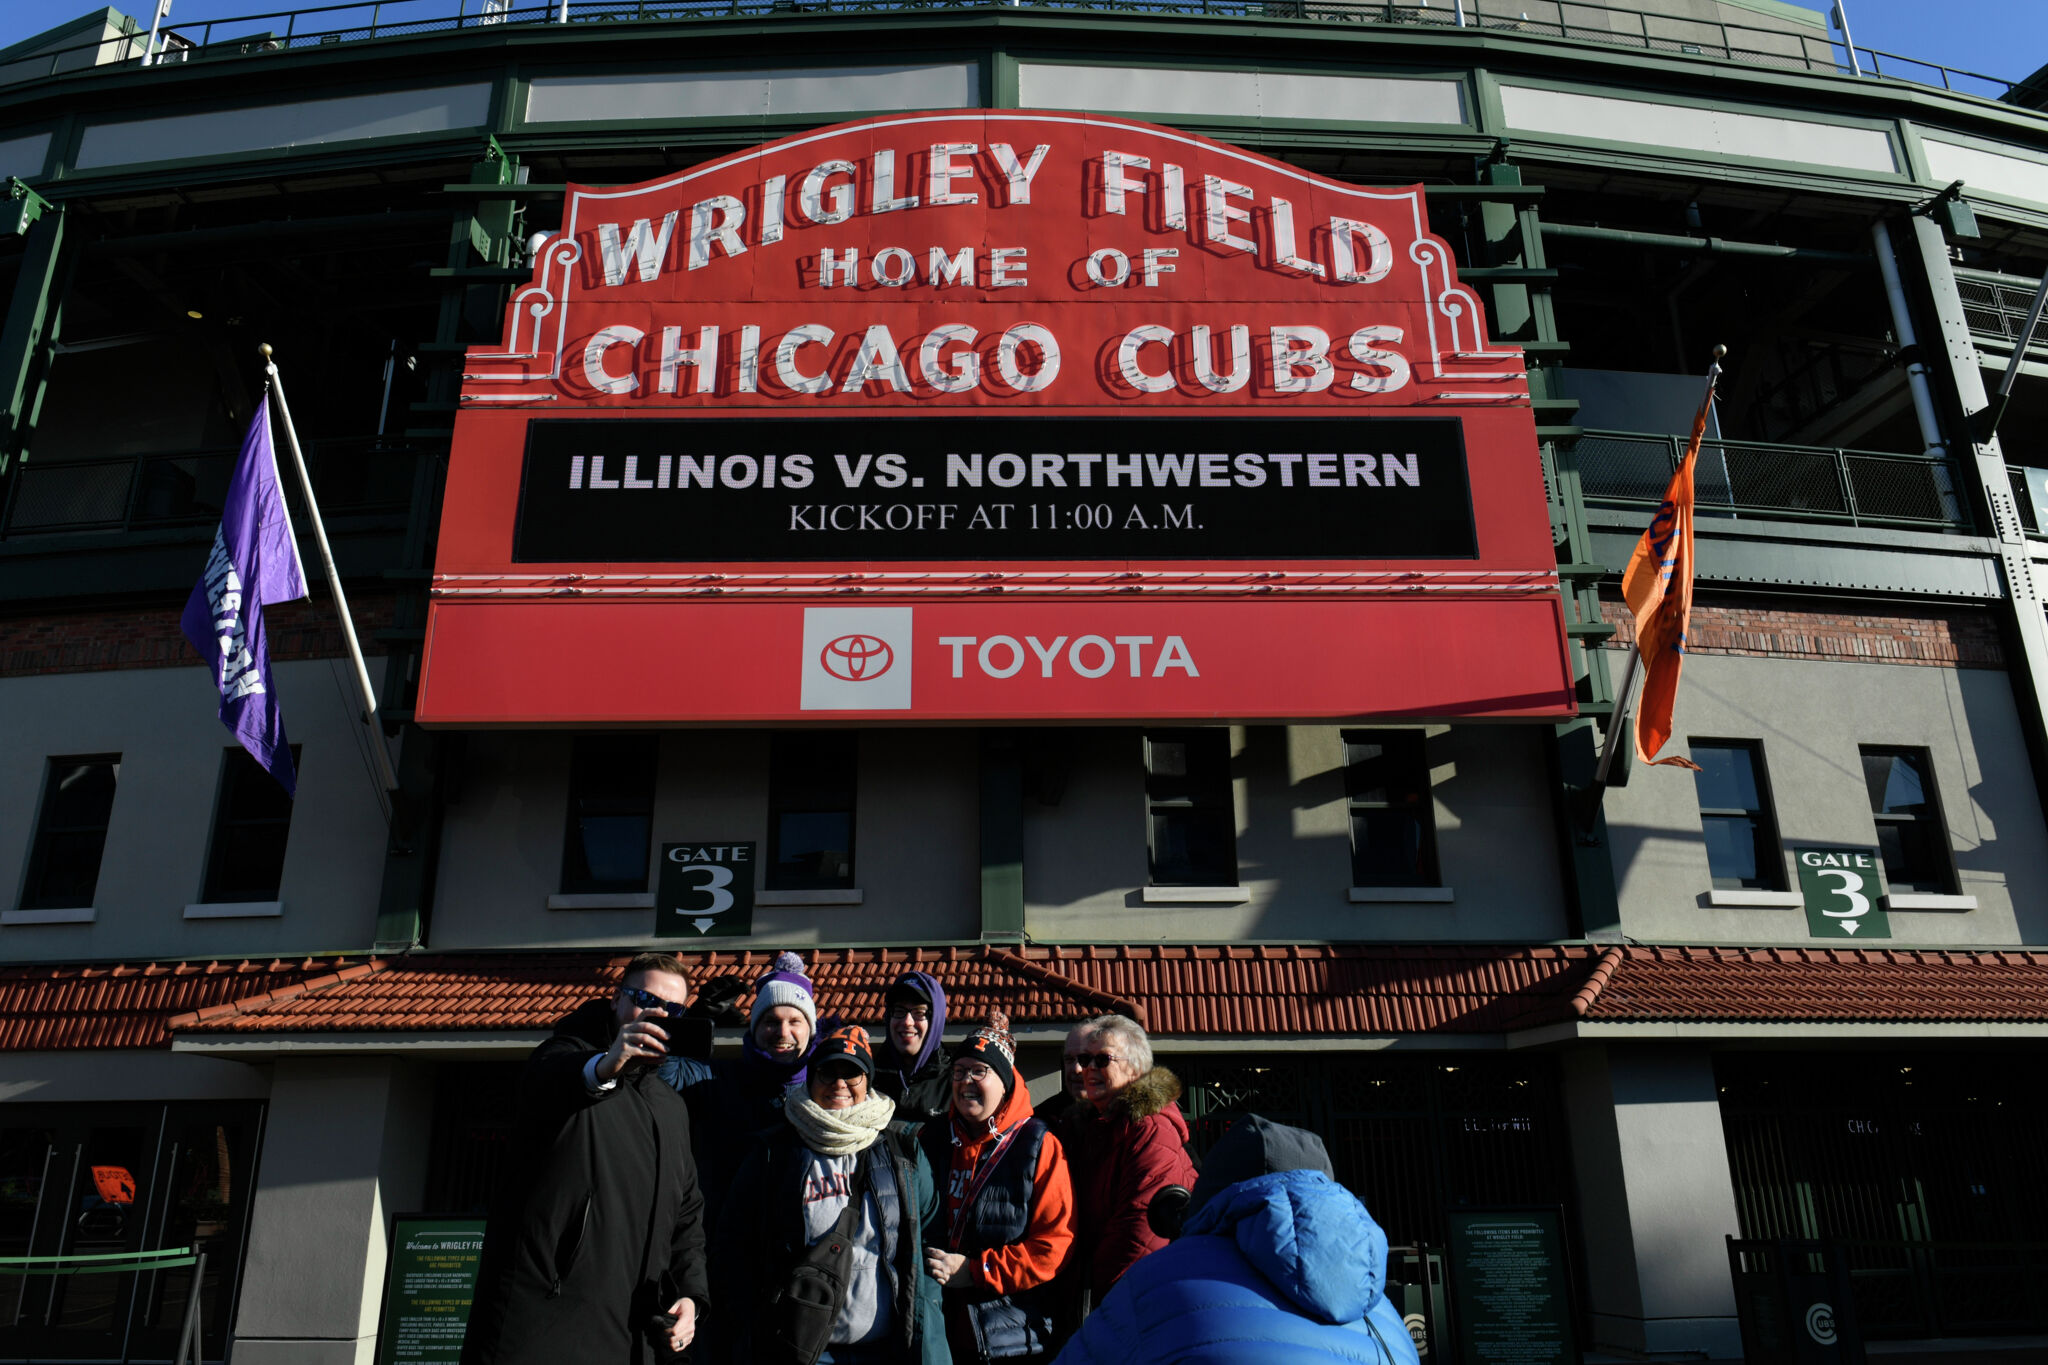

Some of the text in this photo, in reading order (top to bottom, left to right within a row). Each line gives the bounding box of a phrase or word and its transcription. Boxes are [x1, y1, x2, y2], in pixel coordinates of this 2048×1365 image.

[598, 142, 1393, 287] WRIGLEY FIELD
[819, 247, 1179, 288] HOME OF
[582, 322, 1411, 395] CHICAGO CUBS
[568, 453, 1421, 489] ILLINOIS VS. NORTHWESTERN
[788, 503, 1204, 531] KICKOFF AT 11:00 A.M.
[938, 634, 1200, 679] TOYOTA
[668, 846, 750, 863] GATE
[1801, 851, 1872, 868] GATE
[675, 864, 735, 916] 3
[1817, 869, 1870, 918] 3
[440, 1241, 471, 1250] WRIGLEY
[472, 1241, 483, 1250] FIE
